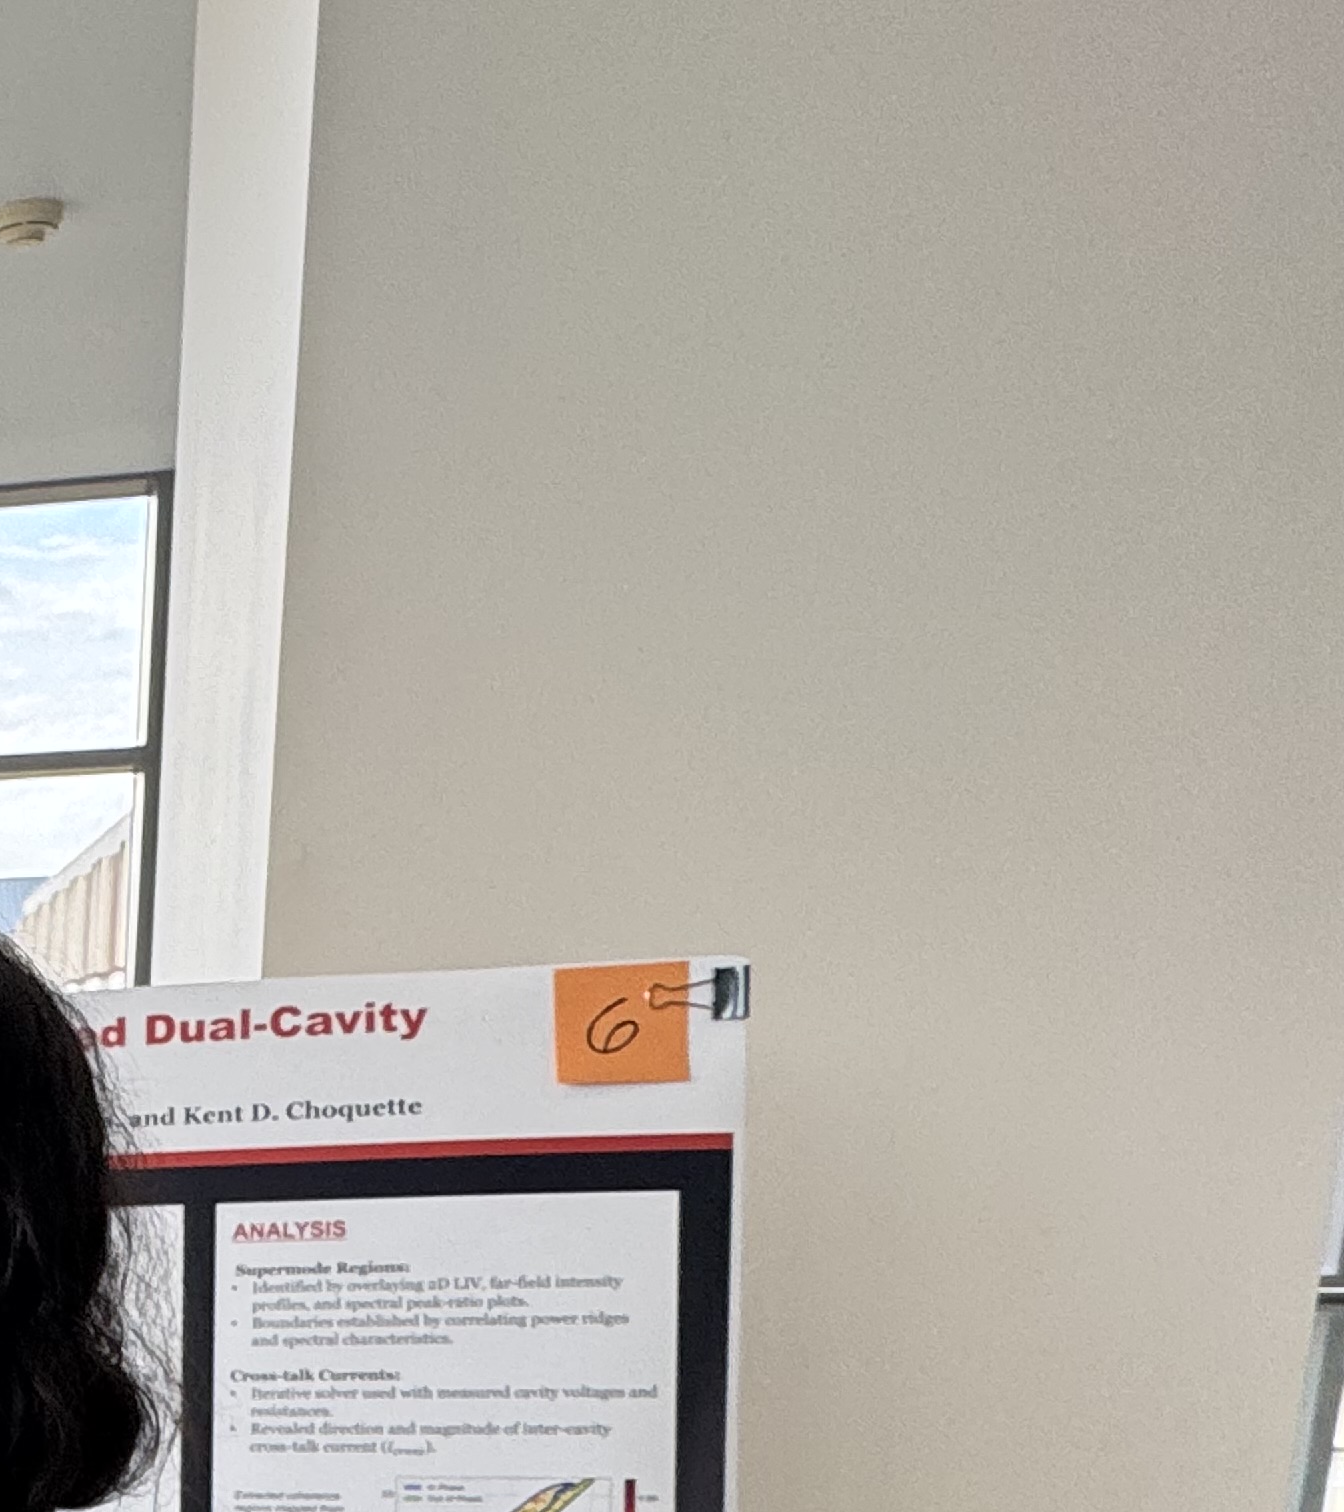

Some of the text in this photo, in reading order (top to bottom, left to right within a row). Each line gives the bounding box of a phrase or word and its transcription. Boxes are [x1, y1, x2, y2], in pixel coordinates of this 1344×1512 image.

[145, 1001, 428, 1046] Dual-Cavity
[586, 996, 640, 1055] 6
[130, 1098, 424, 1128] and Kent D. Choquette
[232, 1219, 348, 1241] ANALYSIS
[555, 1274, 625, 1291] intensity
[531, 1314, 579, 1328] power
[251, 1333, 279, 1346] and
[229, 1368, 315, 1383] Cross-talk
[399, 1384, 434, 1399] with
[628, 1383, 658, 1398] and
